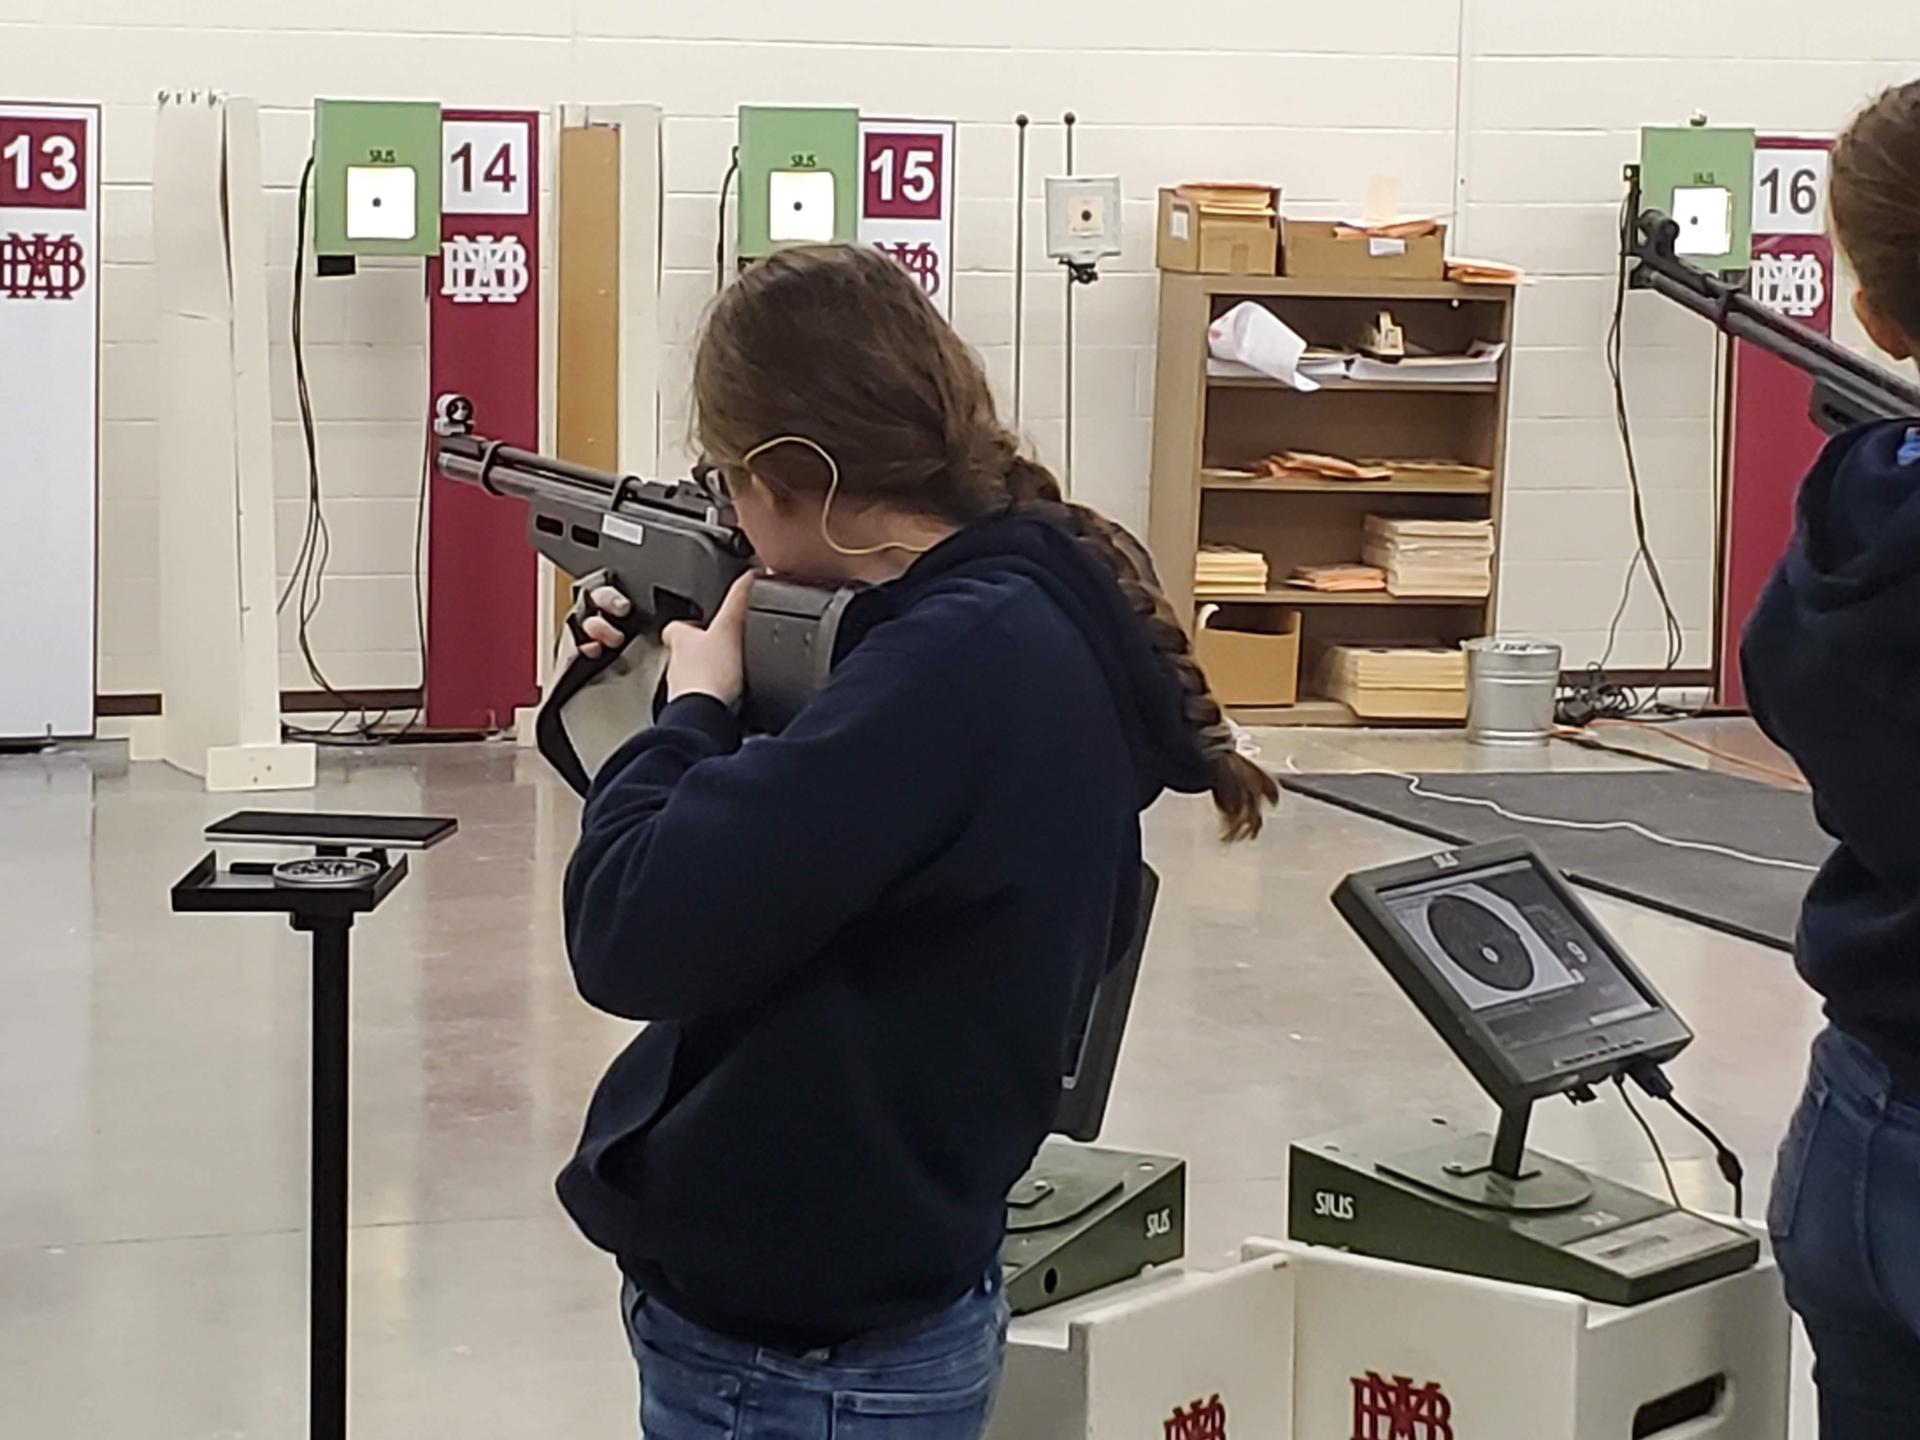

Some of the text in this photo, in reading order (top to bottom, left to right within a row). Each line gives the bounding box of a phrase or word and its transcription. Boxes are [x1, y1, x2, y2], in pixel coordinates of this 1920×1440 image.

[3, 134, 78, 191] 13
[450, 142, 517, 193] 14
[870, 149, 935, 202] 15
[1760, 168, 1817, 215] 16
[1314, 1191, 1354, 1220] SIUS
